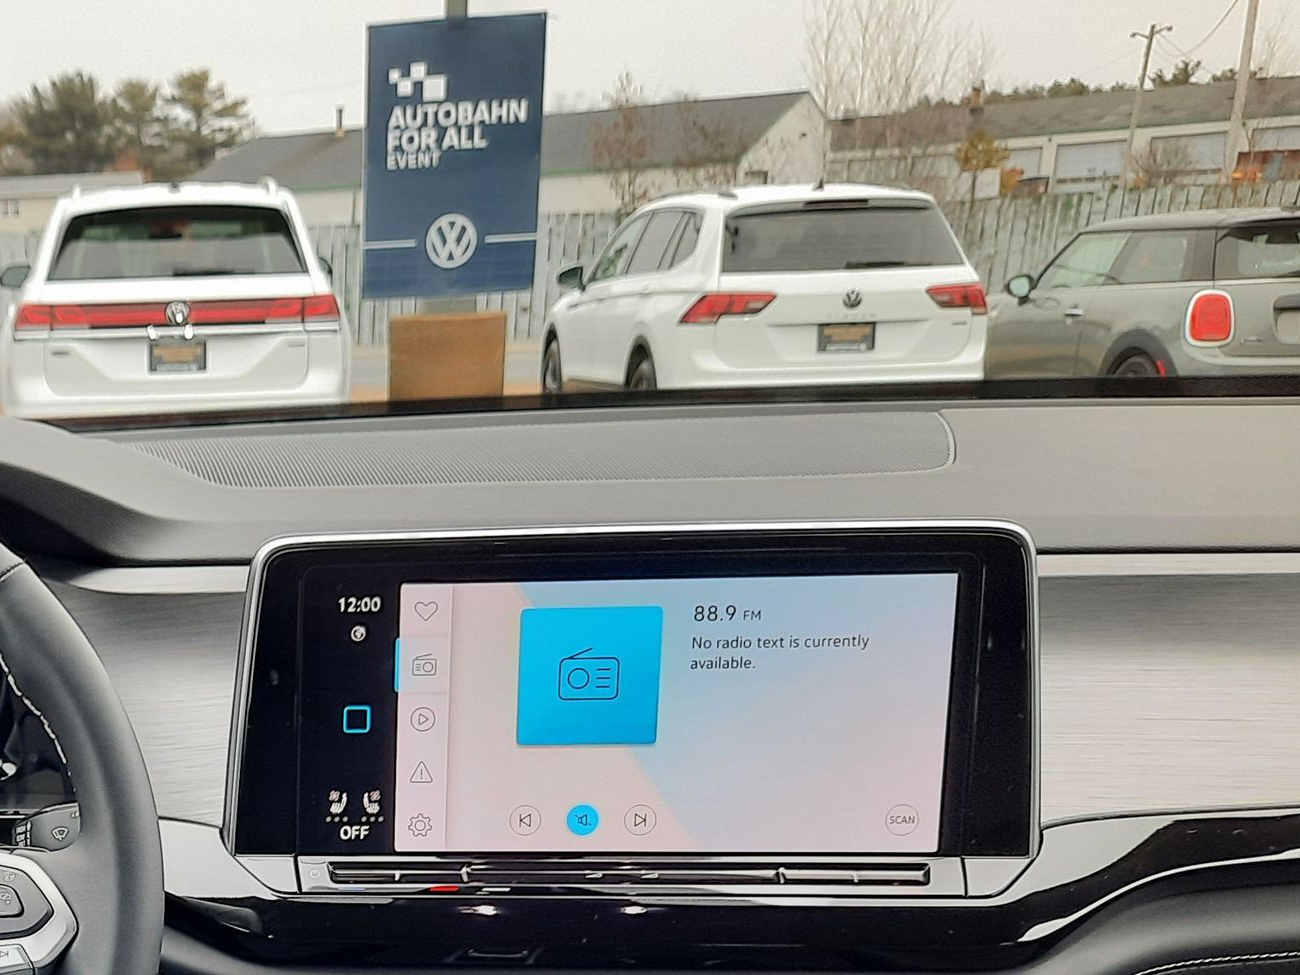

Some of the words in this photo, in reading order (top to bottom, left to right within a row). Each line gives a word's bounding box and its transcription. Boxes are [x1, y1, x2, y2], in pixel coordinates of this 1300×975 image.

[388, 99, 529, 129] AUTOBAHN
[387, 127, 438, 152] FOR
[442, 124, 489, 150] ALL
[386, 151, 441, 171] EVENT
[338, 596, 381, 613] 12:00
[693, 605, 737, 622] 88.9
[742, 609, 762, 621] FM
[691, 636, 712, 650] No
[716, 635, 752, 650] radio
[757, 638, 785, 649] text
[789, 635, 800, 649] is
[804, 634, 870, 651] currently
[690, 656, 756, 670] available.
[889, 814, 916, 826] SCAN
[339, 825, 370, 840] OFF
